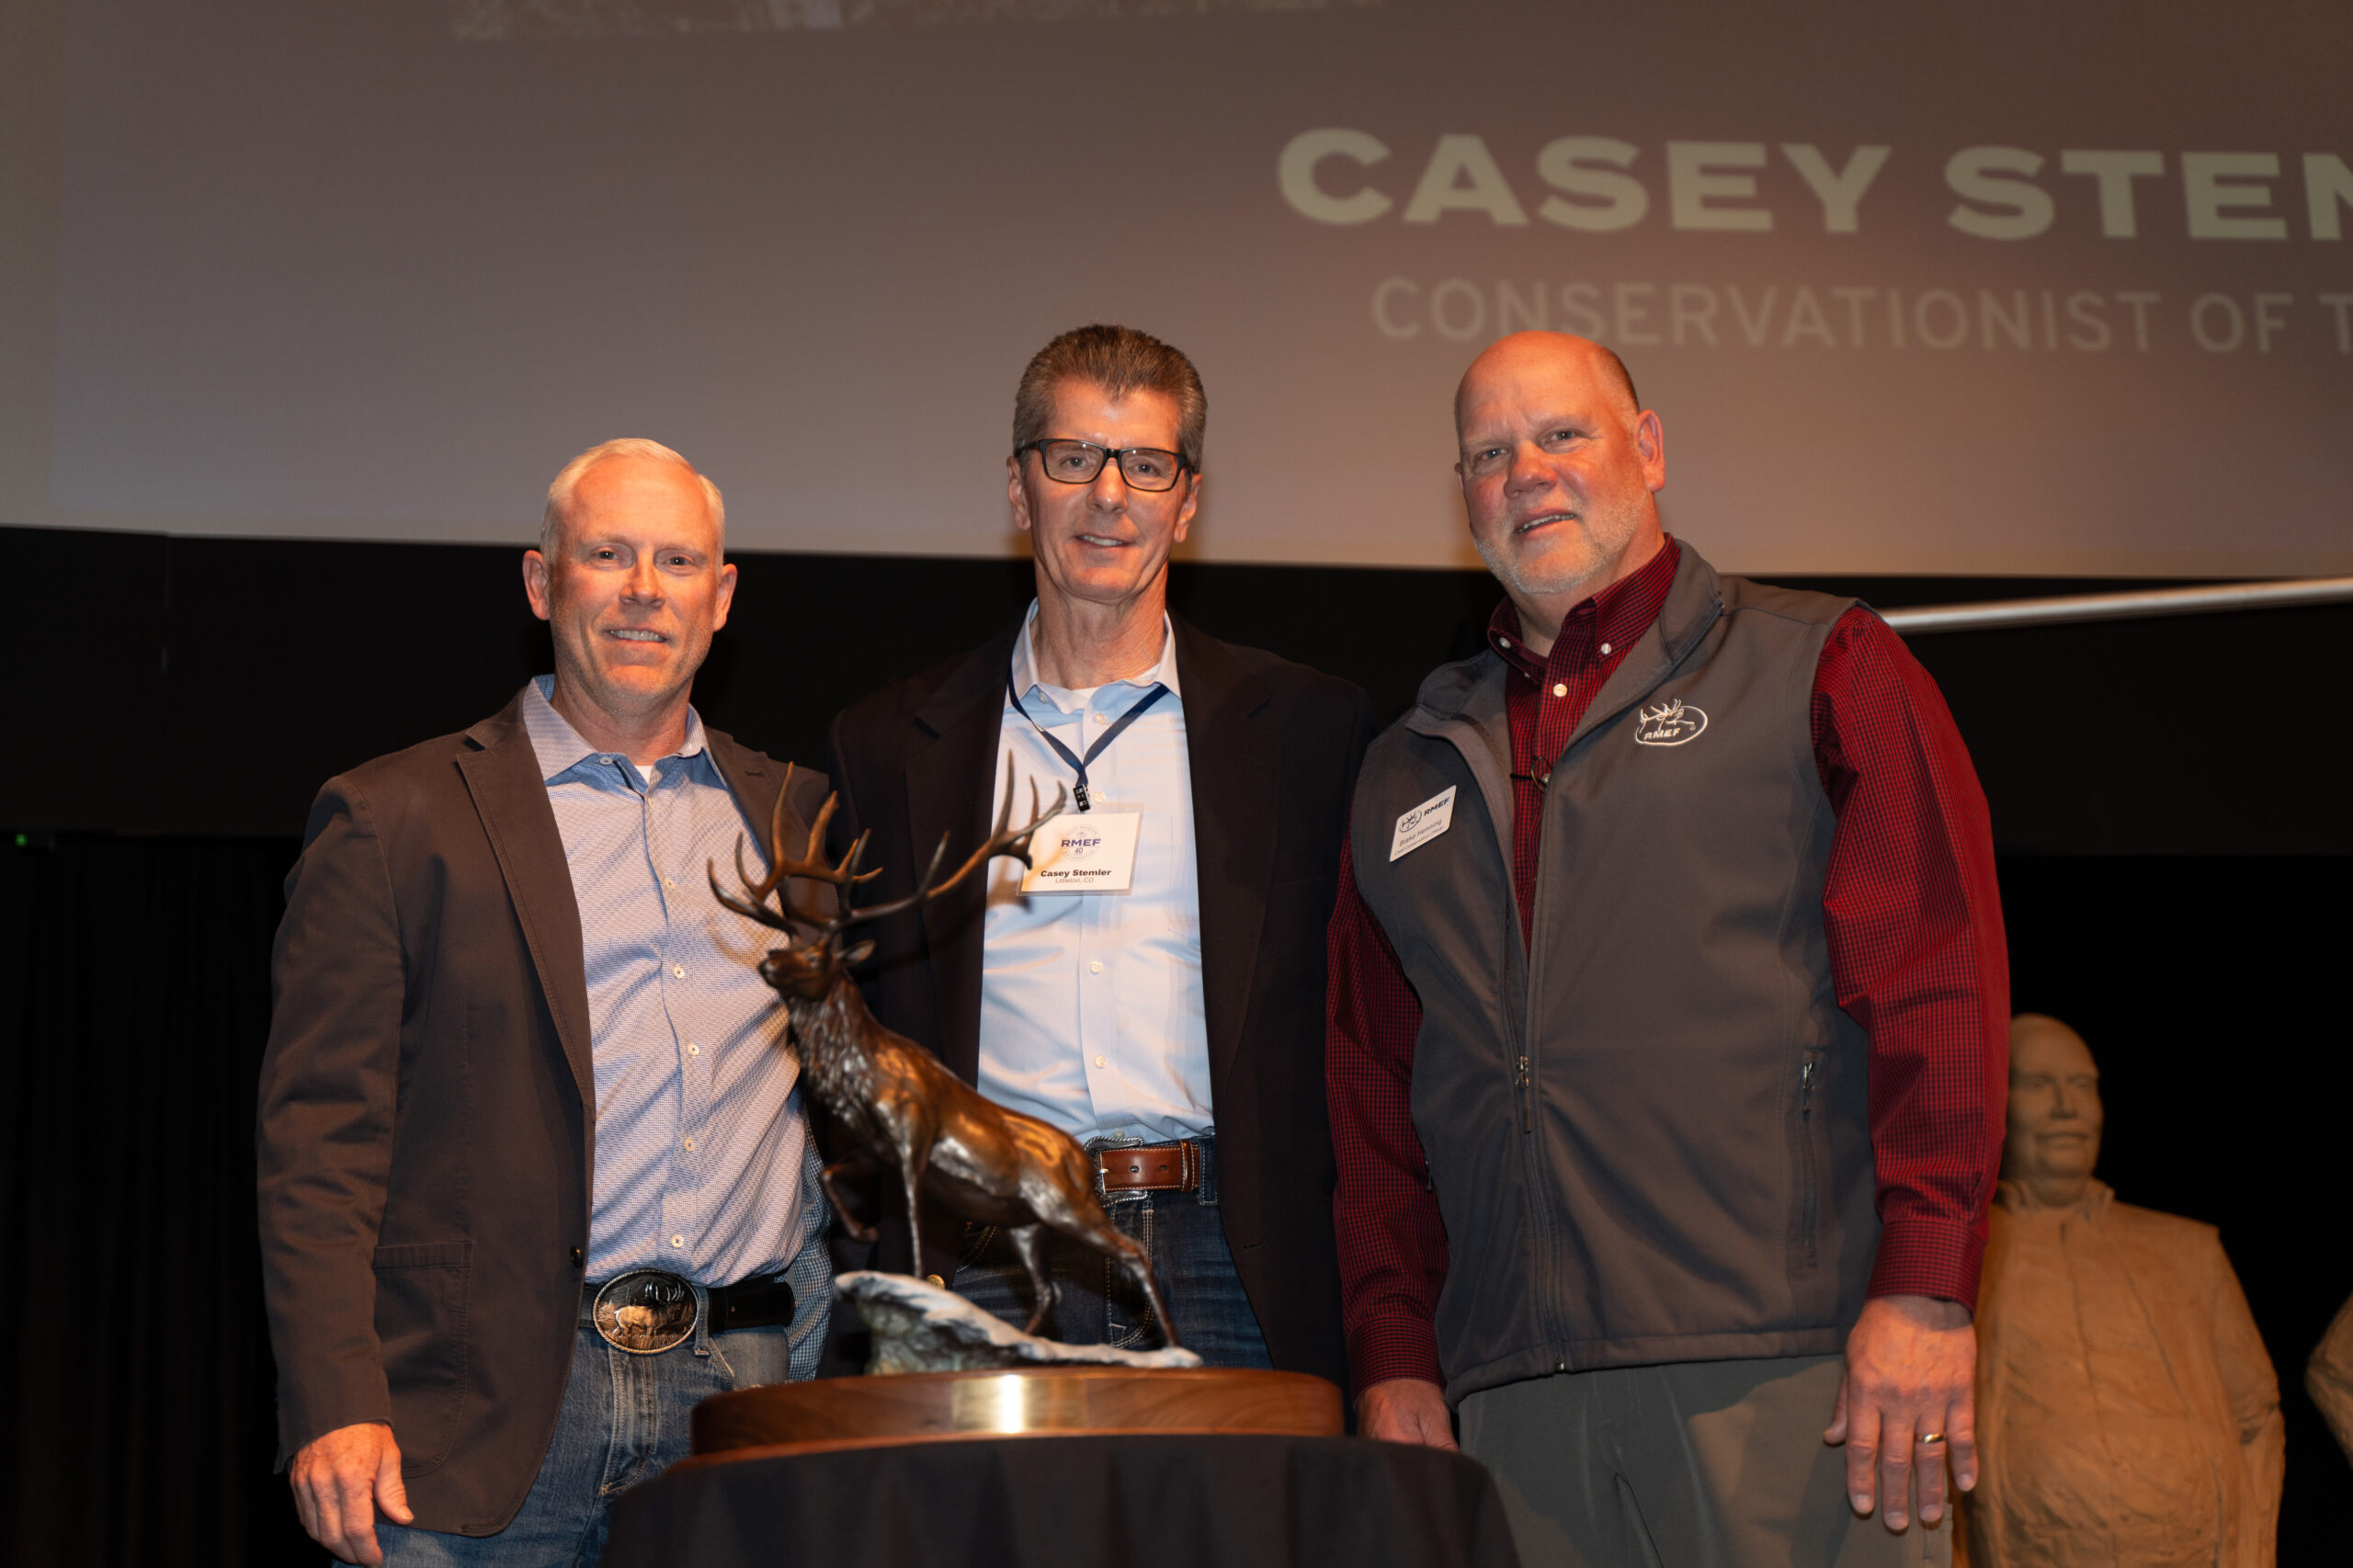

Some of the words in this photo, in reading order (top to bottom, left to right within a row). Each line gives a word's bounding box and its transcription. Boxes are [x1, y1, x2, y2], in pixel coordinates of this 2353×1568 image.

[1278, 127, 1892, 233] CASEY
[1371, 277, 2162, 352] CONSERVATIONIST
[2190, 292, 2293, 354] OF
[1643, 727, 1681, 741] RMEF
[1424, 796, 1450, 816] RMEF
[1061, 838, 1101, 847] RMEF
[1040, 870, 1070, 879] Casey
[1072, 869, 1112, 877] Stemler
